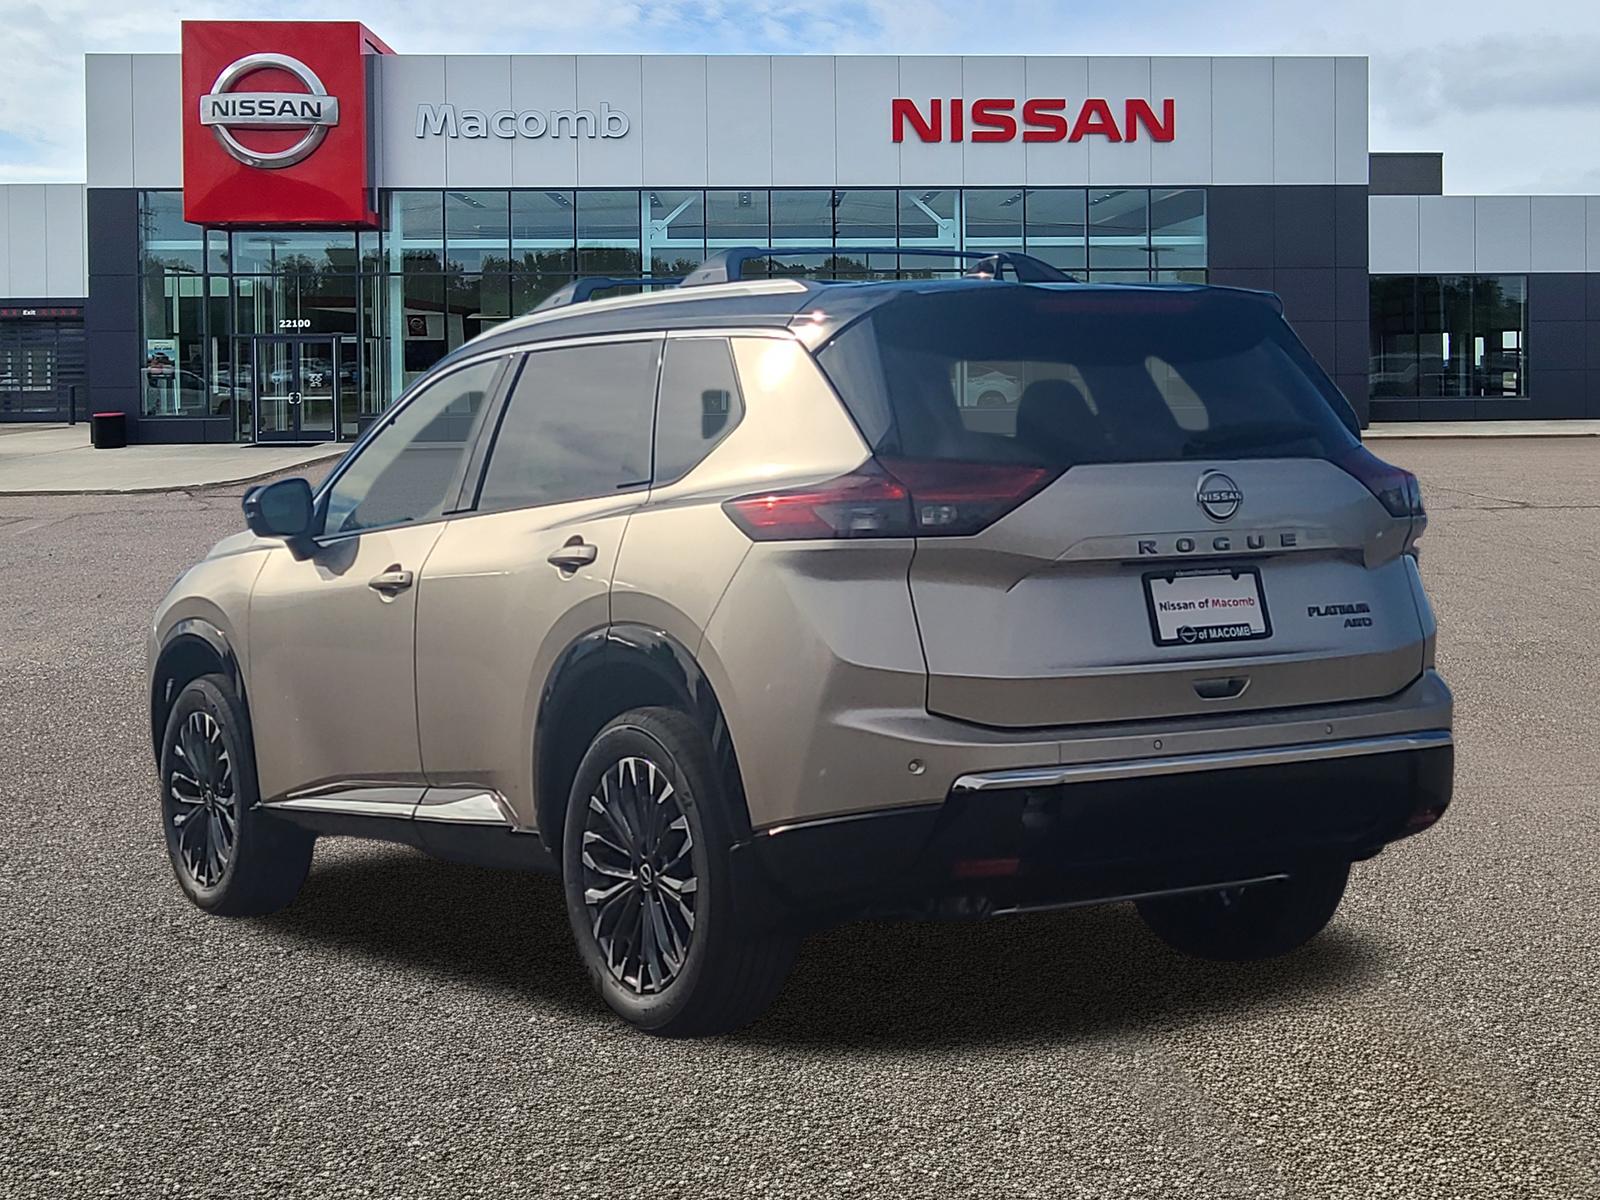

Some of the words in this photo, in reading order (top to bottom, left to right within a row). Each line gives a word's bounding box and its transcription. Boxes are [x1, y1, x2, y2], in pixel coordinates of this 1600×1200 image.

[212, 100, 322, 117] NISSAN
[415, 102, 630, 138] Macomb
[892, 98, 1175, 143] NISSAN
[279, 319, 311, 328] 22100
[1199, 491, 1242, 501] NISSAN
[1138, 533, 1297, 555] ROGUE
[1159, 601, 1196, 611] Nissan
[1198, 598, 1210, 609] of
[1211, 597, 1255, 608] Macomb
[1198, 628, 1209, 639] of
[1209, 625, 1251, 638] MACOMB
